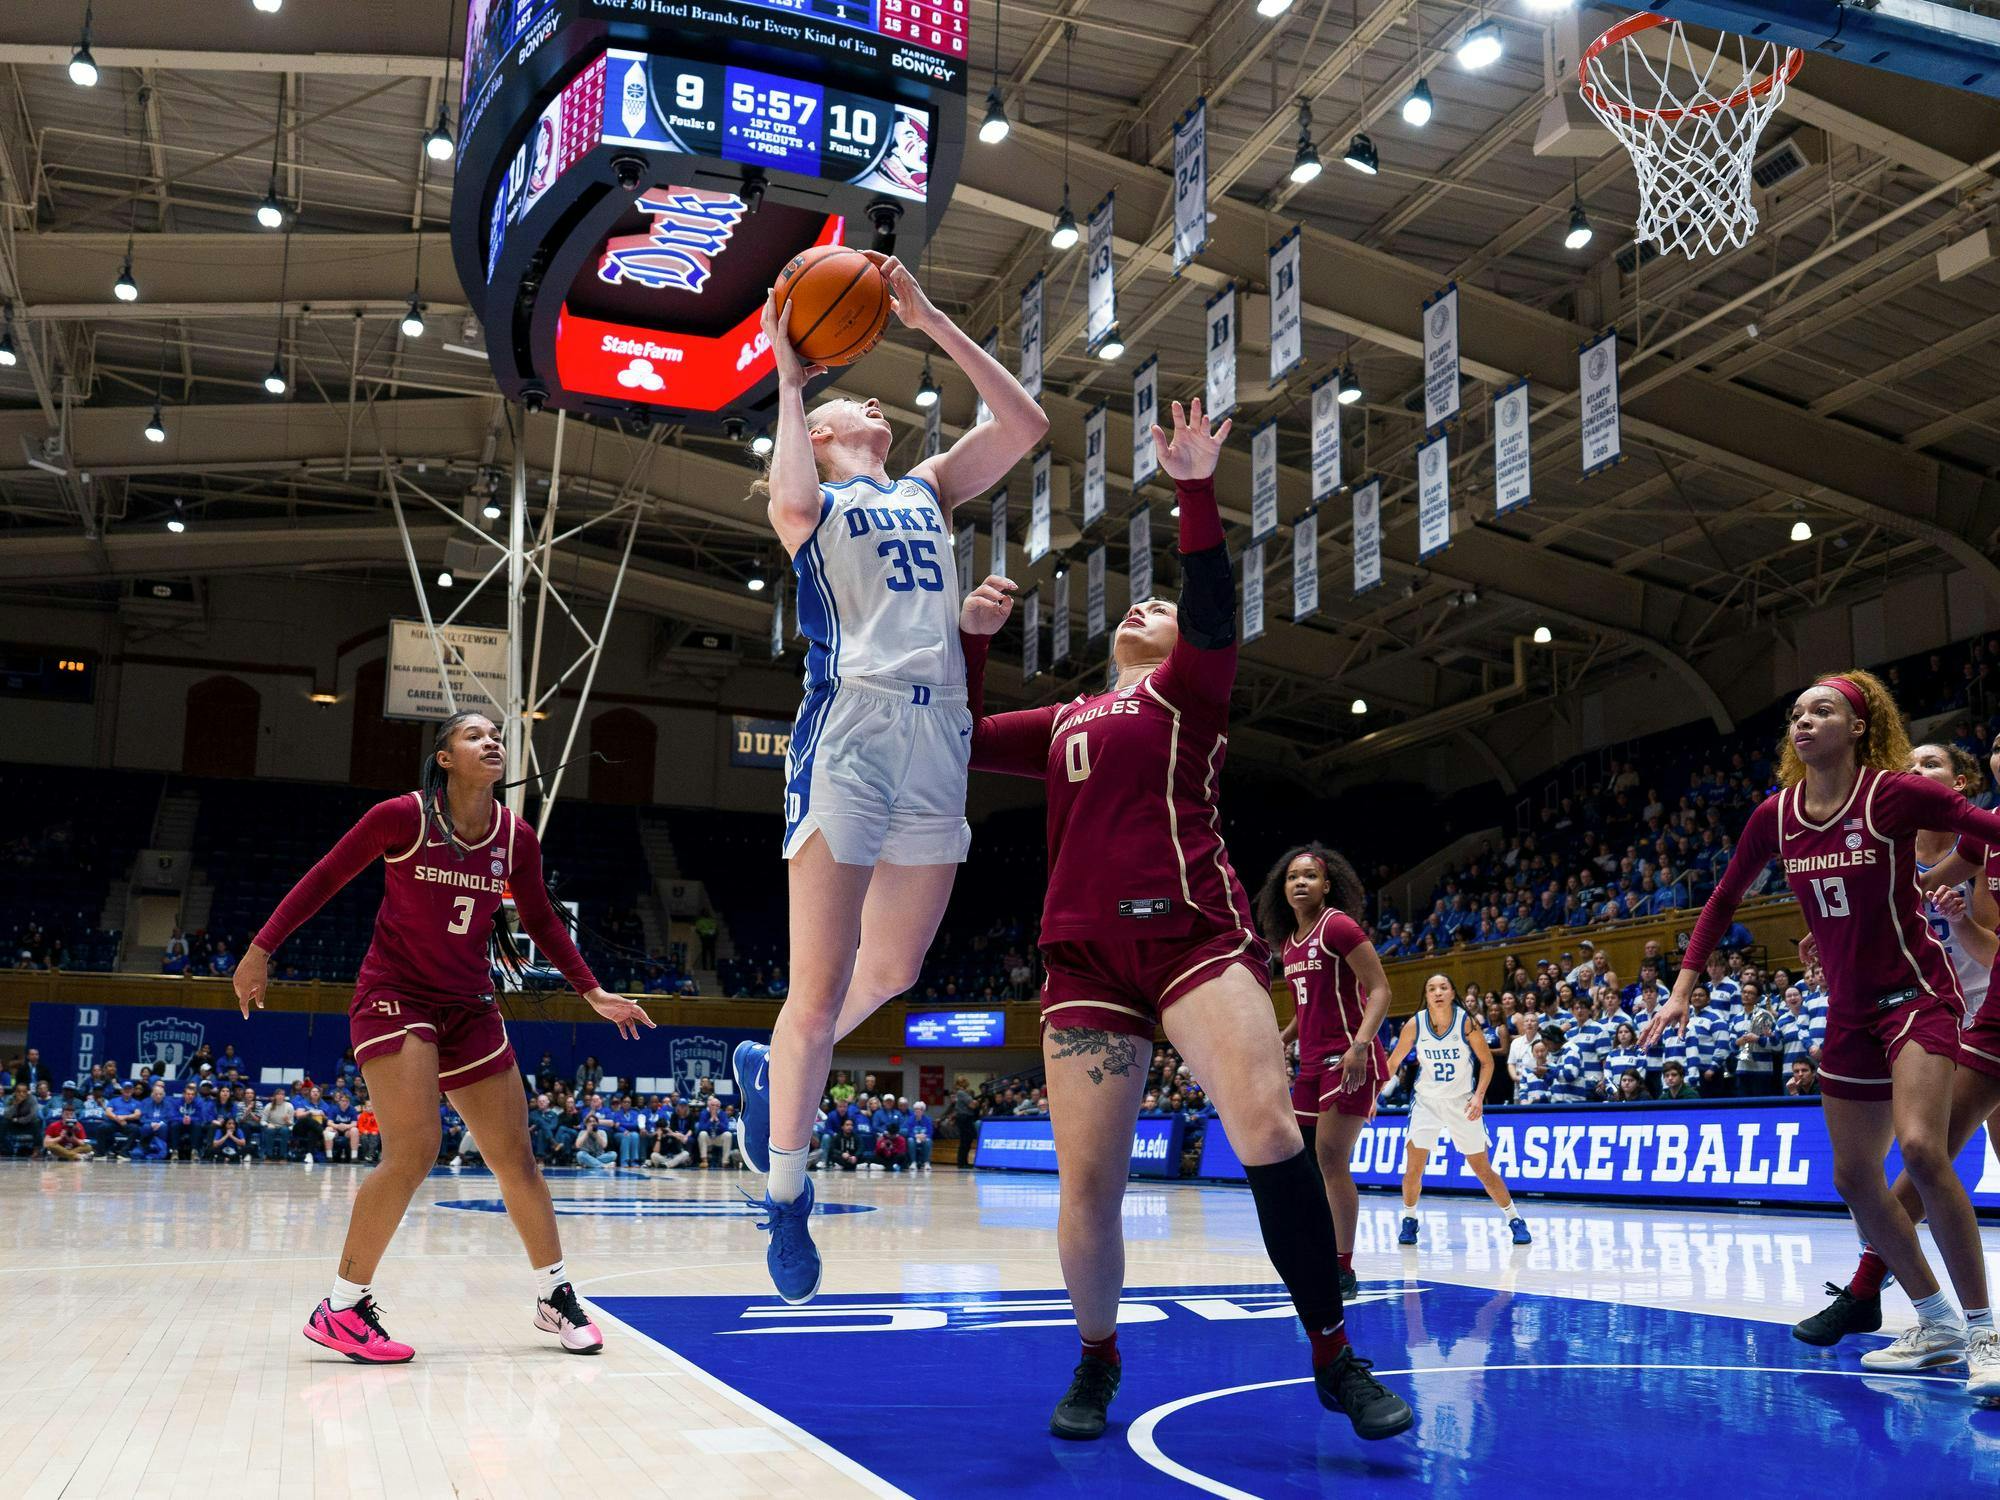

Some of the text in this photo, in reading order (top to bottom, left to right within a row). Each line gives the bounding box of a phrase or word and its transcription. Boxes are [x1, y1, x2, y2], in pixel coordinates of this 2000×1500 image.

[515, 7, 533, 36] AST
[836, 5, 847, 18] 1
[910, 5, 921, 18] 0
[931, 12, 942, 25] 0
[953, 19, 963, 32] 1
[518, 12, 562, 65] BONVOY
[650, 0, 687, 17] Hotel
[692, 6, 739, 25] Brands
[741, 15, 761, 29] for
[764, 19, 801, 39] Every
[804, 27, 836, 46] Kind
[839, 37, 853, 50] of
[855, 40, 878, 57] Fan
[884, 17, 963, 51] 15 2 0 0
[891, 54, 954, 82] BONVOY
[900, 48, 947, 67] MARRIOTT
[675, 73, 705, 111] 9
[731, 82, 818, 126] 5:57
[669, 114, 716, 132] Fouls: 0
[750, 117, 797, 136] 1ST QTR
[829, 104, 877, 145] 10
[729, 126, 816, 151] 4 TIMEOUTS 4
[757, 142, 788, 157] POSS
[829, 141, 871, 159] Fouls: 1
[1178, 155, 1201, 203] 24
[1091, 245, 1110, 281] 43
[1429, 340, 1452, 362] ATLANTIC
[1433, 352, 1449, 371] COAST
[1425, 359, 1457, 387] CONFERENCE
[1426, 371, 1456, 397] CHAMPIONS
[1586, 384, 1611, 405] ATLANTIC
[1590, 397, 1608, 414] COAST
[1582, 403, 1617, 429] CONFERENCE
[1583, 415, 1616, 440] CHAMPIONS
[1500, 431, 1523, 448] ATLANTIC
[1503, 442, 1520, 458] COAST
[1592, 444, 1609, 460] 2005
[1497, 448, 1528, 471] CONFERENCE
[1498, 461, 1527, 480] CHAMPIONS
[1505, 486, 1520, 500] 2004
[844, 507, 942, 539] DUKE
[877, 539, 945, 592] 35
[407, 689, 443, 700] CAREER
[911, 685, 931, 706] D
[416, 704, 450, 714] NOVEMBE
[1055, 700, 1142, 738] MINOLES
[737, 731, 791, 757] DUK
[1065, 732, 1092, 783] 0
[788, 792, 801, 823] D
[1783, 849, 1877, 874] SEMINOLES
[414, 865, 506, 895] SEMINOLES
[1809, 877, 1850, 918] 13
[447, 896, 476, 935] 3
[1292, 976, 1308, 1006] 15
[143, 1030, 198, 1046] SISTERHOOD
[1423, 1048, 1461, 1060] DUKE
[1433, 1062, 1456, 1082] 22
[1131, 1132, 1170, 1160] ke.edu
[1349, 1122, 1810, 1186] DUE ASKETBALL
